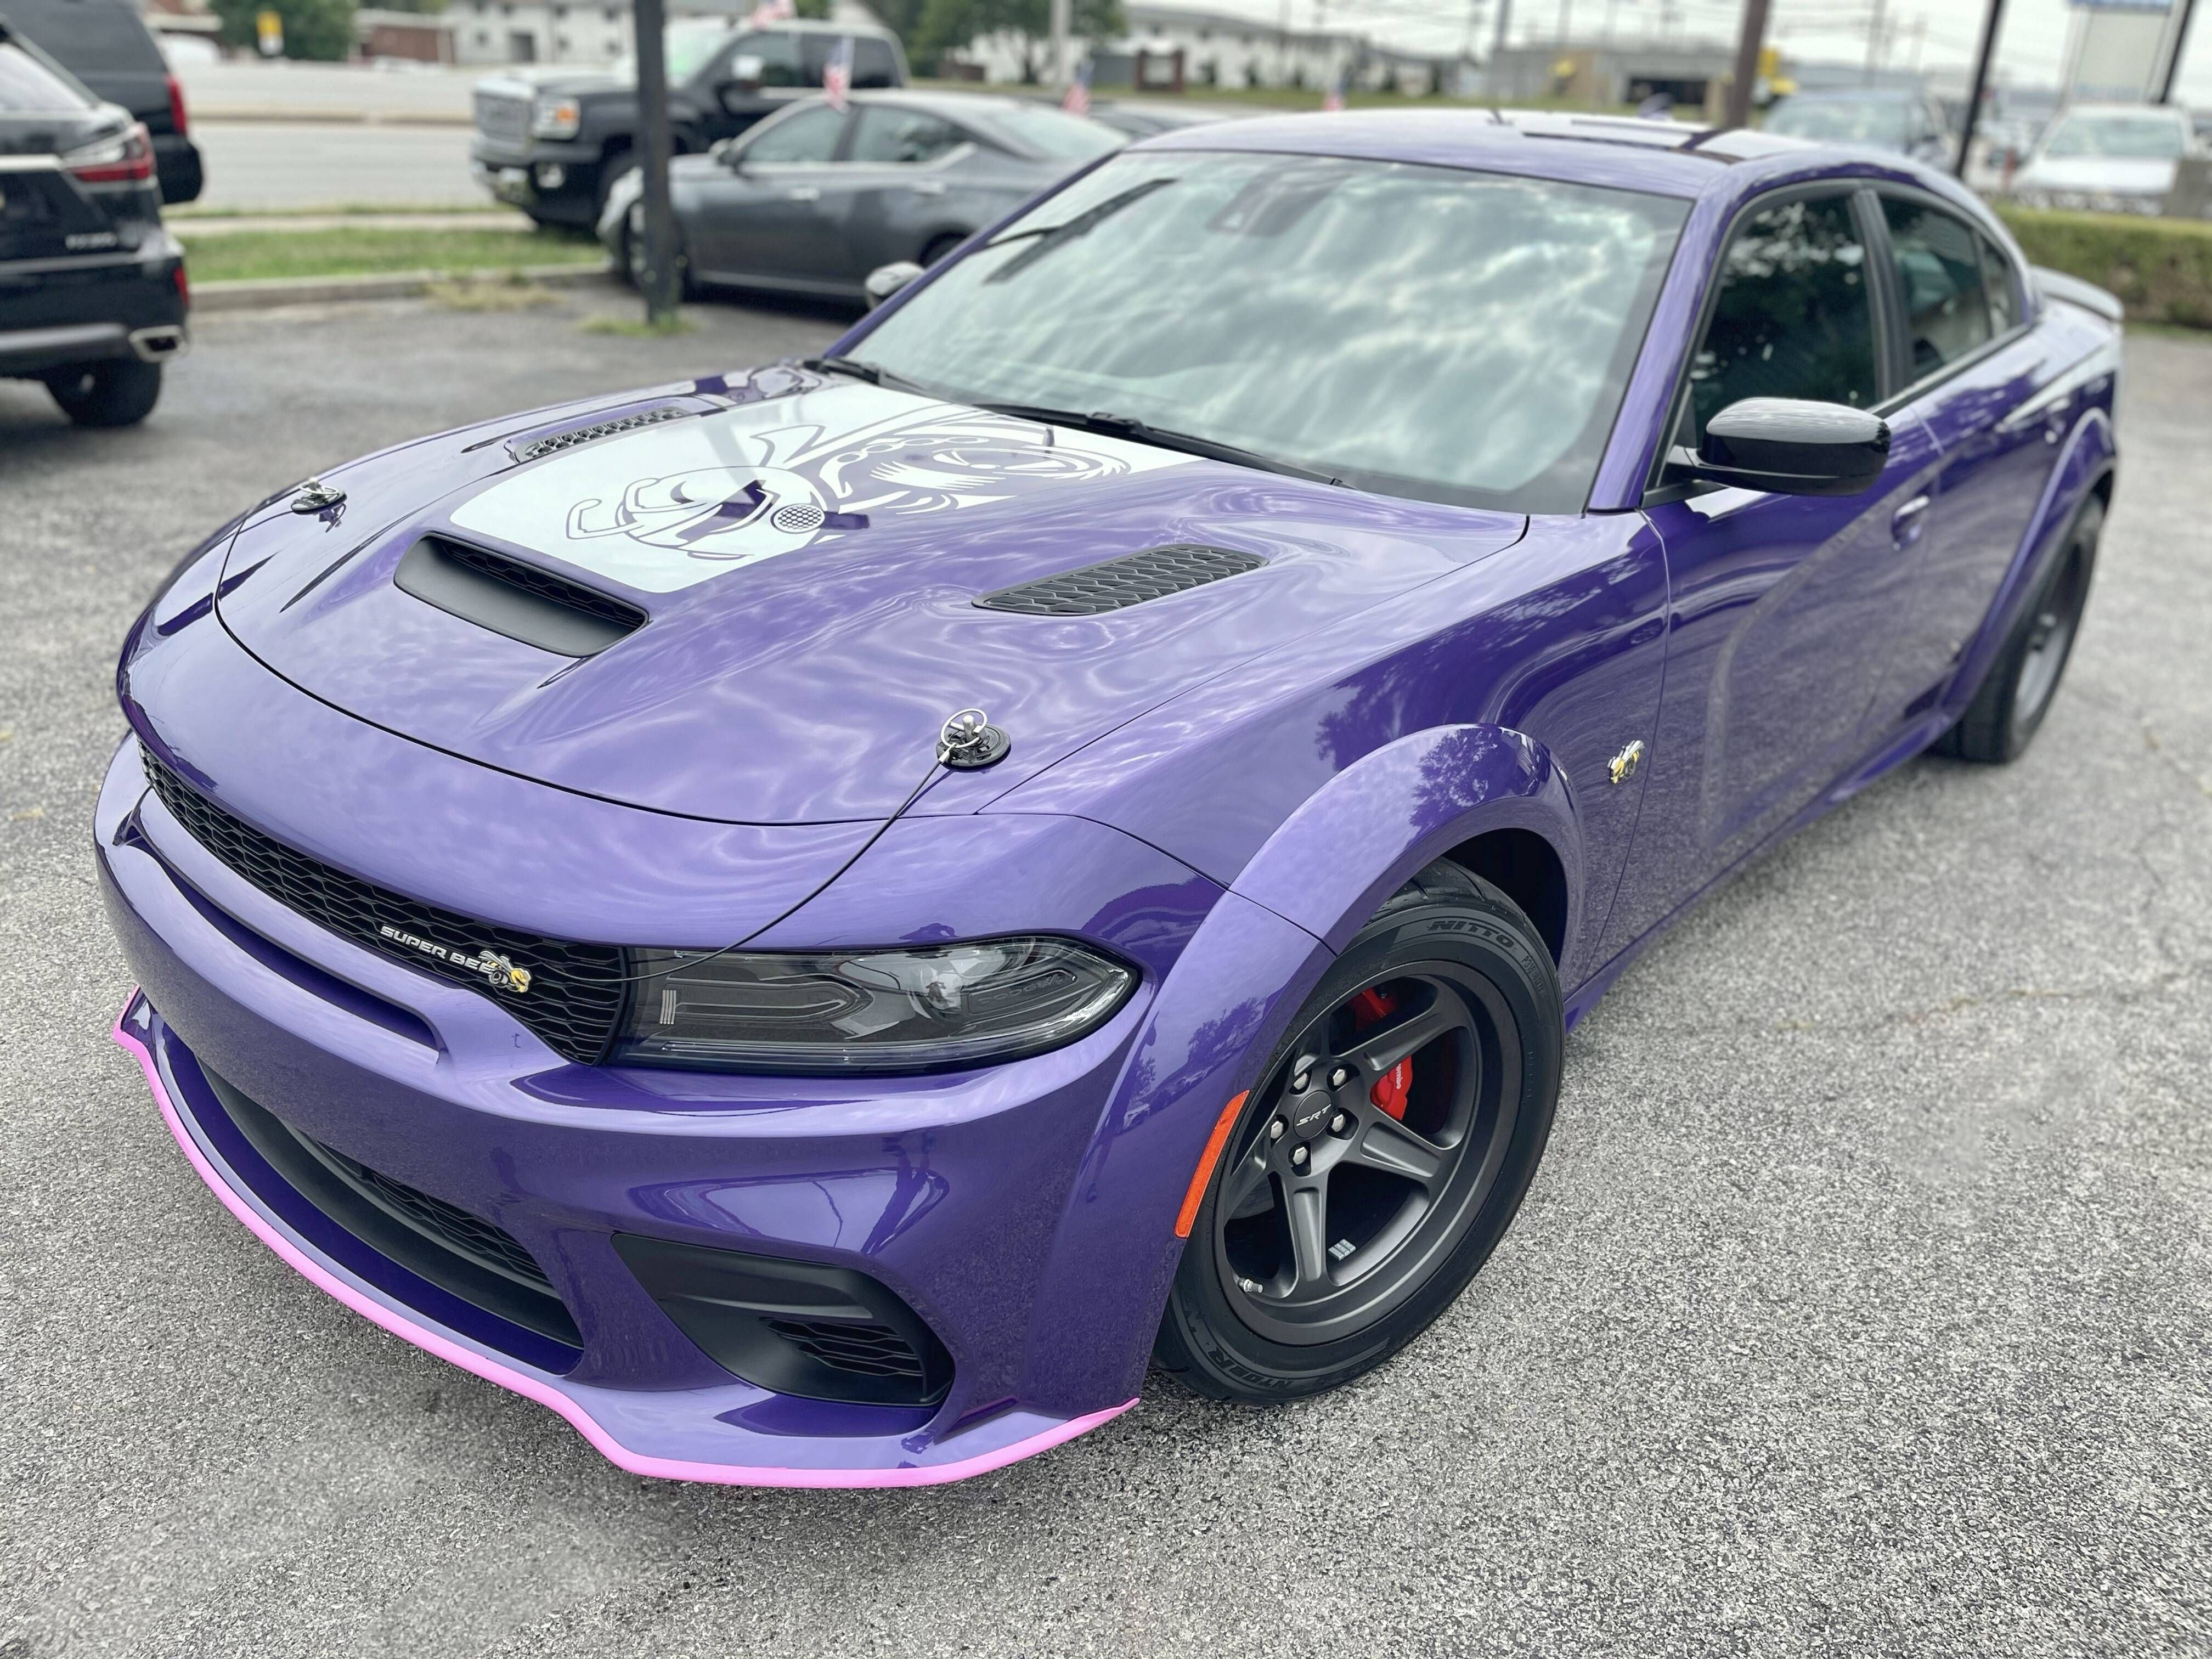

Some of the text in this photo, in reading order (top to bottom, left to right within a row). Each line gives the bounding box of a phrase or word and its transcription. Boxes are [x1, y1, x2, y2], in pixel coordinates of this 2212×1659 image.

[1428, 920, 1515, 949] NITTO
[380, 926, 495, 975] SUPER BEE
[1296, 1104, 1331, 1126] SRT
